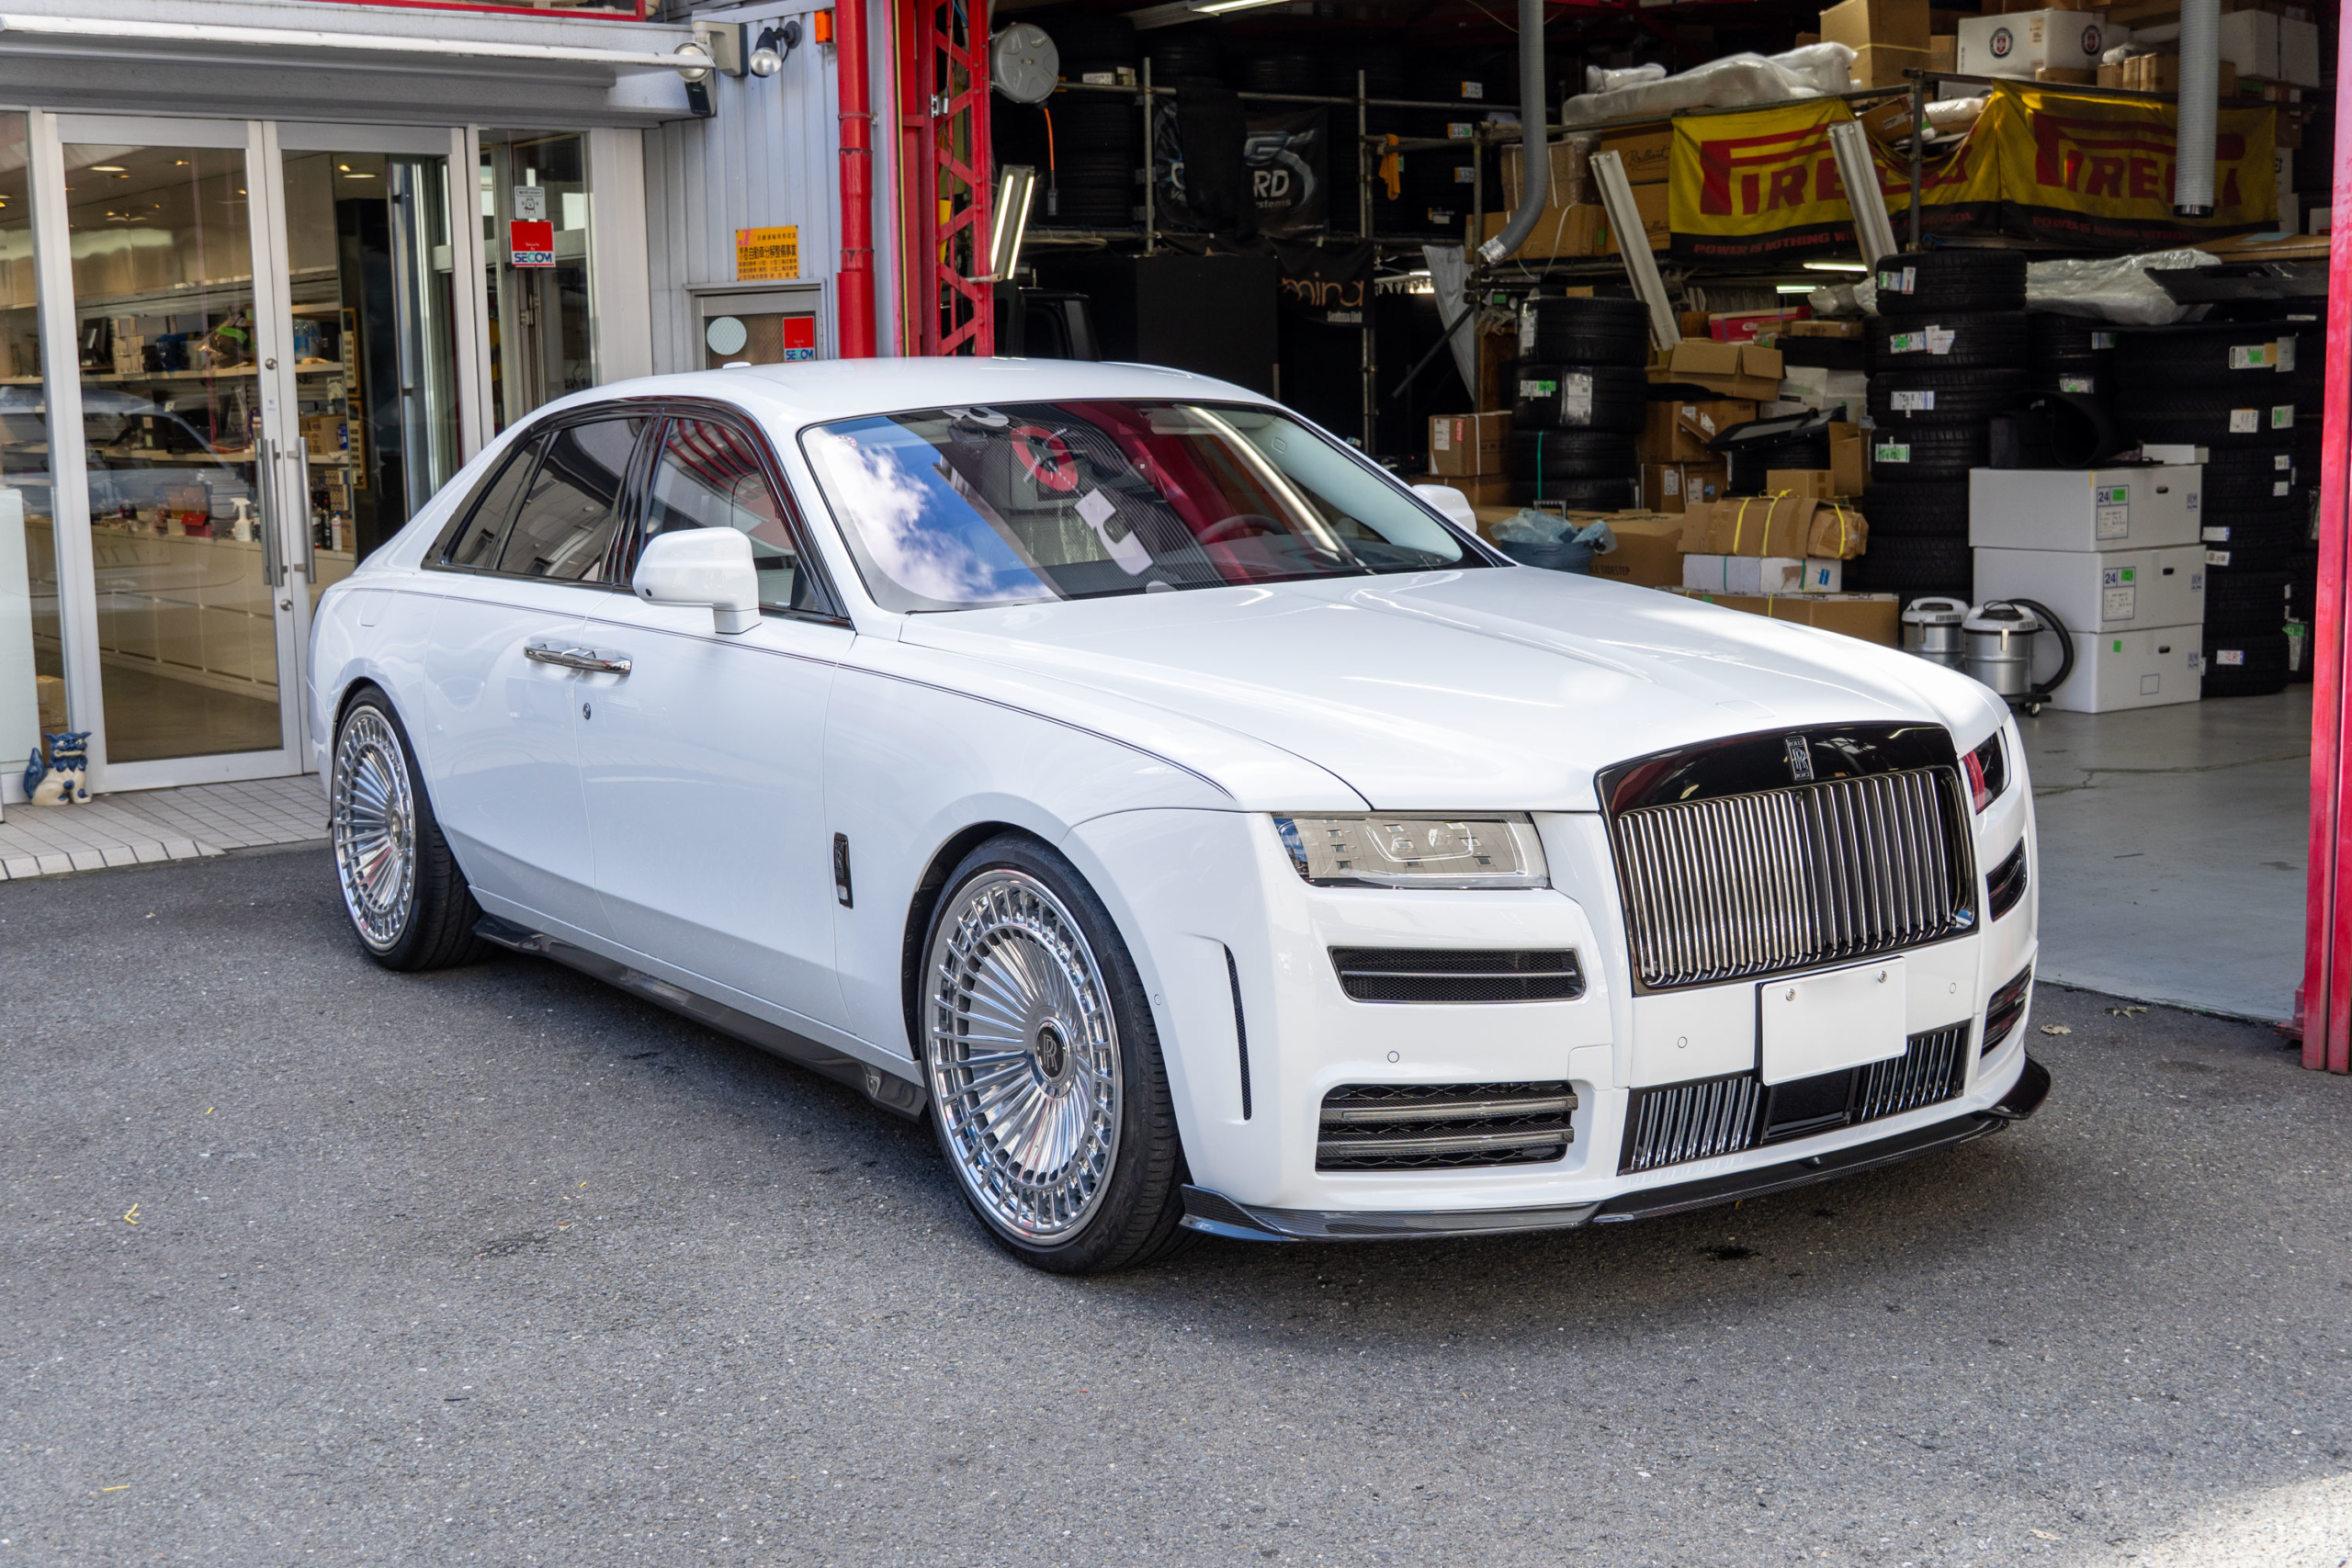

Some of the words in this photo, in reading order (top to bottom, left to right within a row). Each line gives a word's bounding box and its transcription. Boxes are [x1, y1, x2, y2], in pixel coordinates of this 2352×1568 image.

[2033, 113, 2247, 207] PIREI
[1693, 243, 1748, 255] POWER
[1749, 243, 1764, 254] IS
[1765, 232, 1833, 252] NOTHING
[514, 252, 552, 263] SECOM
[786, 349, 814, 360] SECOM
[2098, 491, 2109, 502] 24
[1600, 564, 1631, 576] SIDESTEP
[2104, 572, 2116, 584] 24
[1791, 748, 1809, 771] RR
[1043, 1033, 1058, 1072] RR
